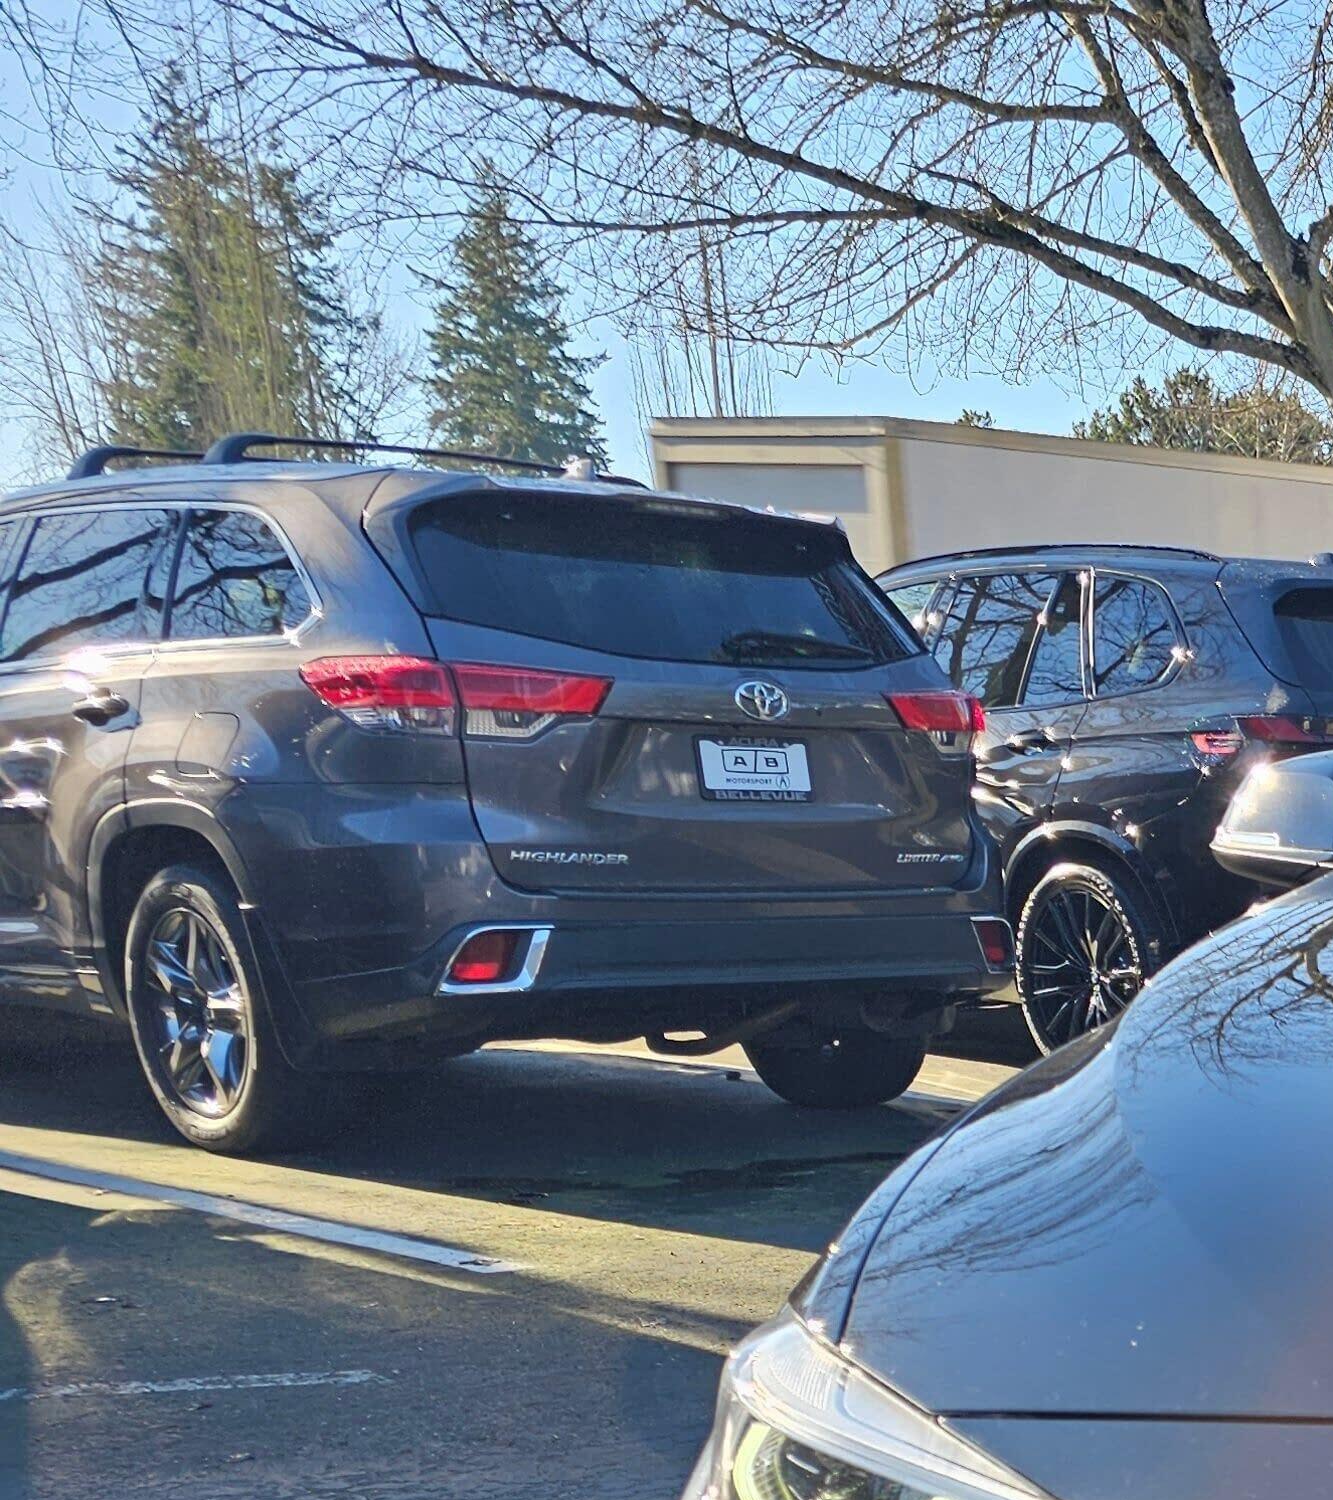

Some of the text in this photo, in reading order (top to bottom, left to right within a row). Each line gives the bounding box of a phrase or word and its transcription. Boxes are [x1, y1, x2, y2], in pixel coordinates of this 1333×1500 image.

[728, 737, 779, 747] ACURA
[715, 790, 807, 801] BELLEVUE
[510, 849, 629, 865] HIGHLANDER
